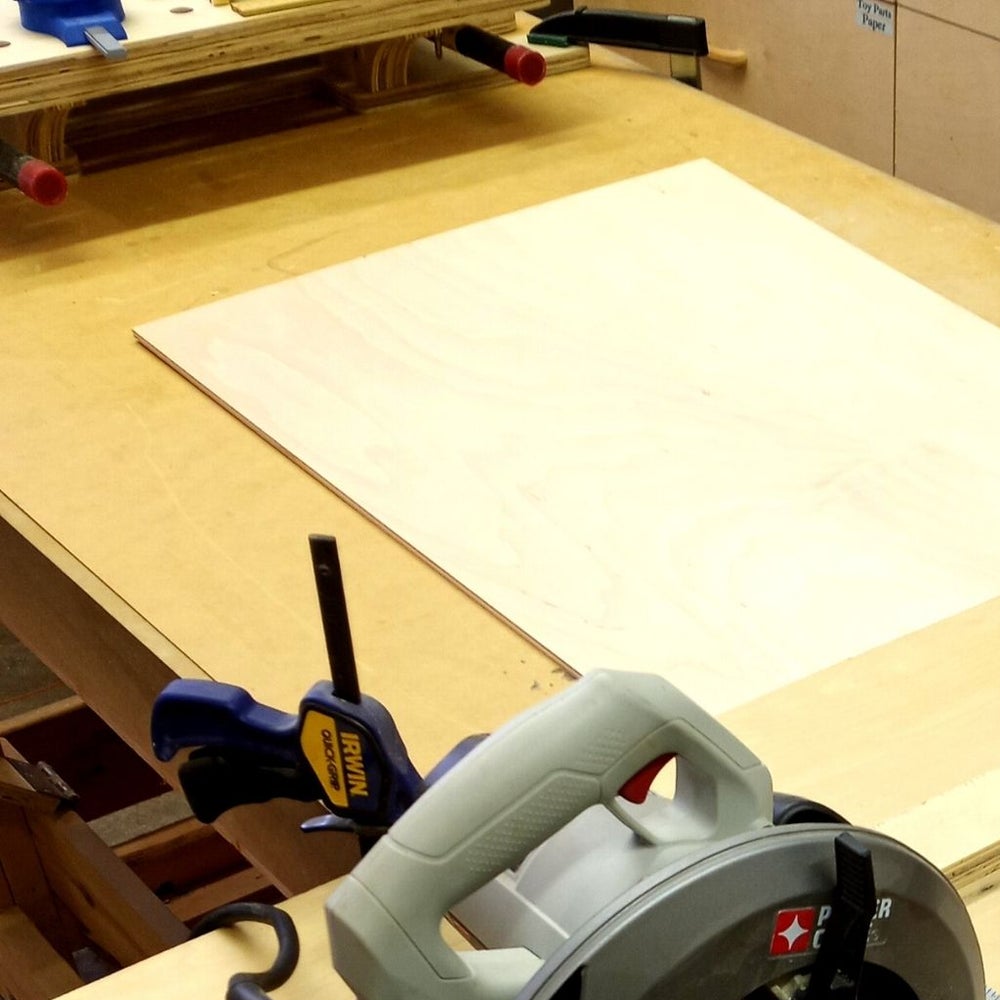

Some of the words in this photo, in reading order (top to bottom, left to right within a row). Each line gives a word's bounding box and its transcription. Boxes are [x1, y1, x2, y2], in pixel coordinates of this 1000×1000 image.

[873, 3, 892, 19] Parts
[862, 12, 886, 31] Paper
[340, 731, 369, 797] IRWIN
